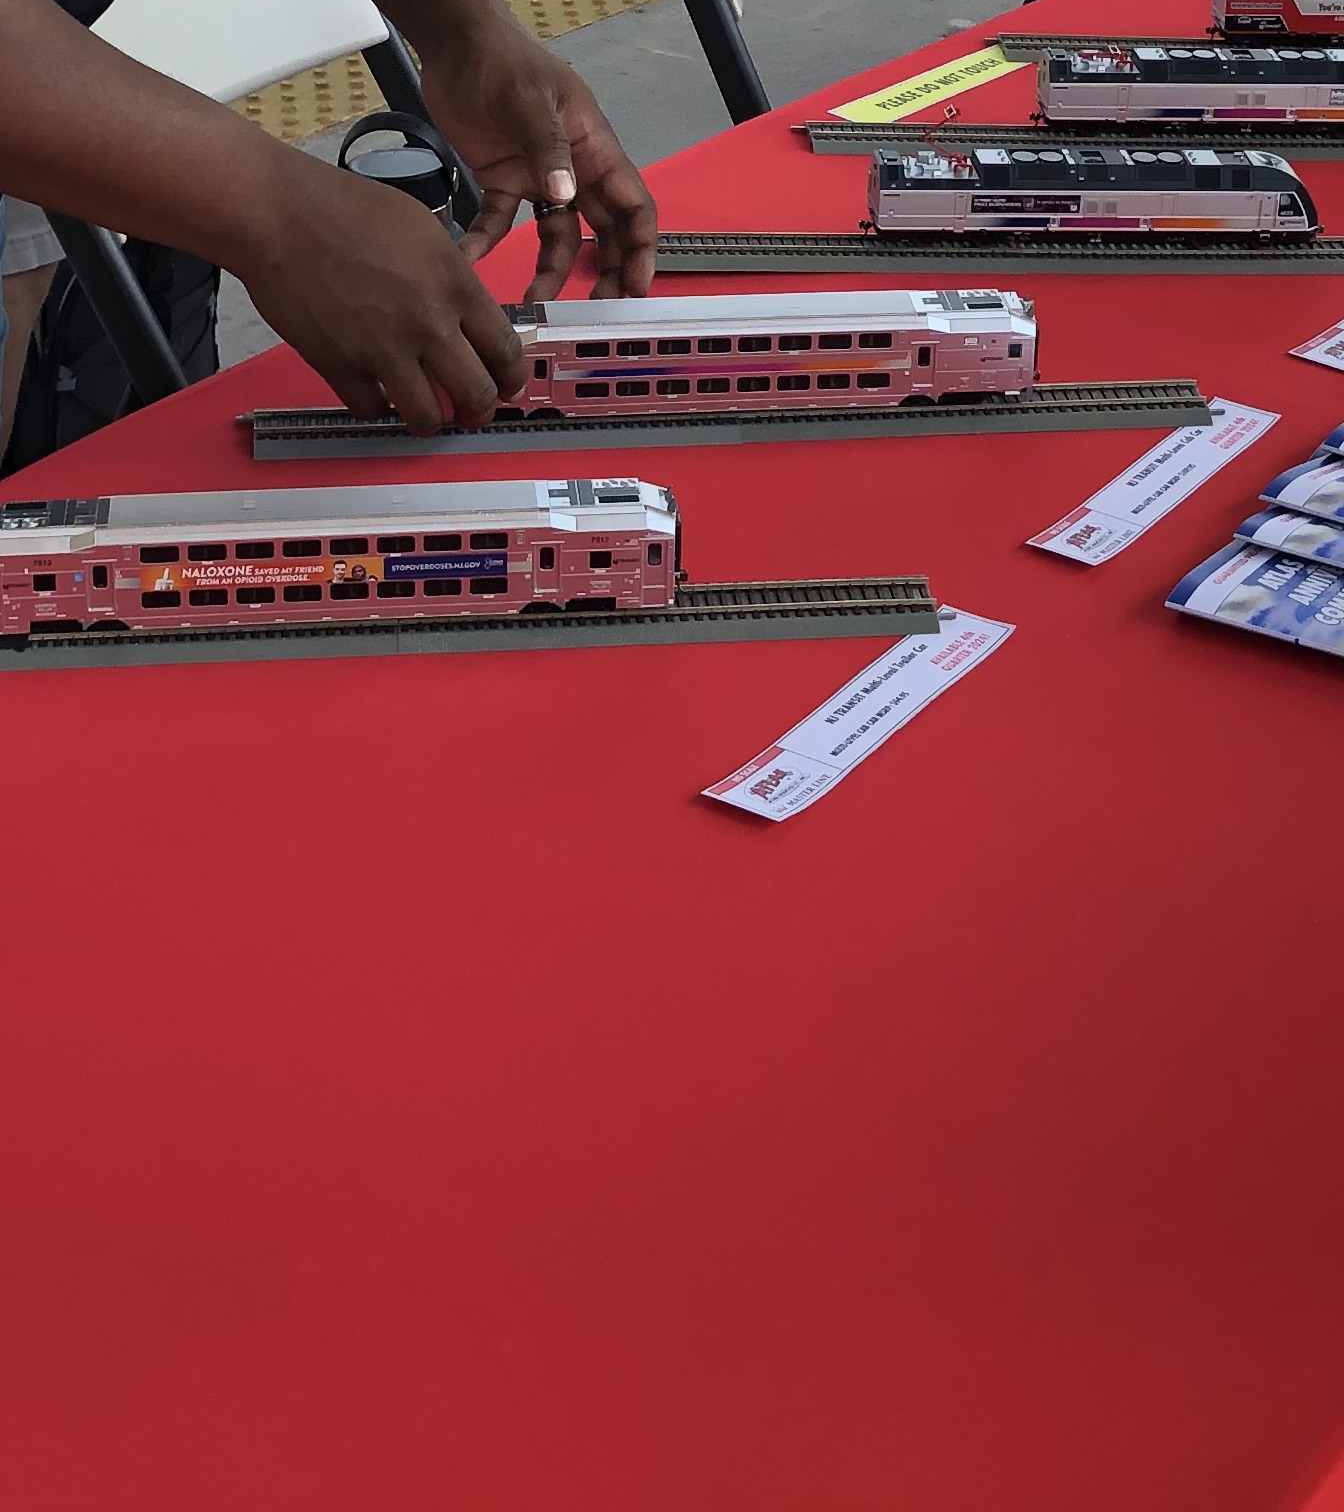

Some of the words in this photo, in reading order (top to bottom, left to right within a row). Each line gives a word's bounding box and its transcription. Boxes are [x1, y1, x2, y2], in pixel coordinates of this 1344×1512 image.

[875, 89, 923, 111] PLEASE
[916, 83, 941, 94] DO
[936, 72, 965, 87] NOT
[958, 58, 1004, 77] TOUCH
[182, 564, 254, 579] NALOXONE
[295, 565, 325, 574] FRIEND
[196, 578, 219, 586] FROM
[1257, 558, 1305, 591] ATLAS
[825, 714, 839, 725] NJ
[833, 692, 865, 717] TRANSIT
[786, 787, 815, 807] MASTER
